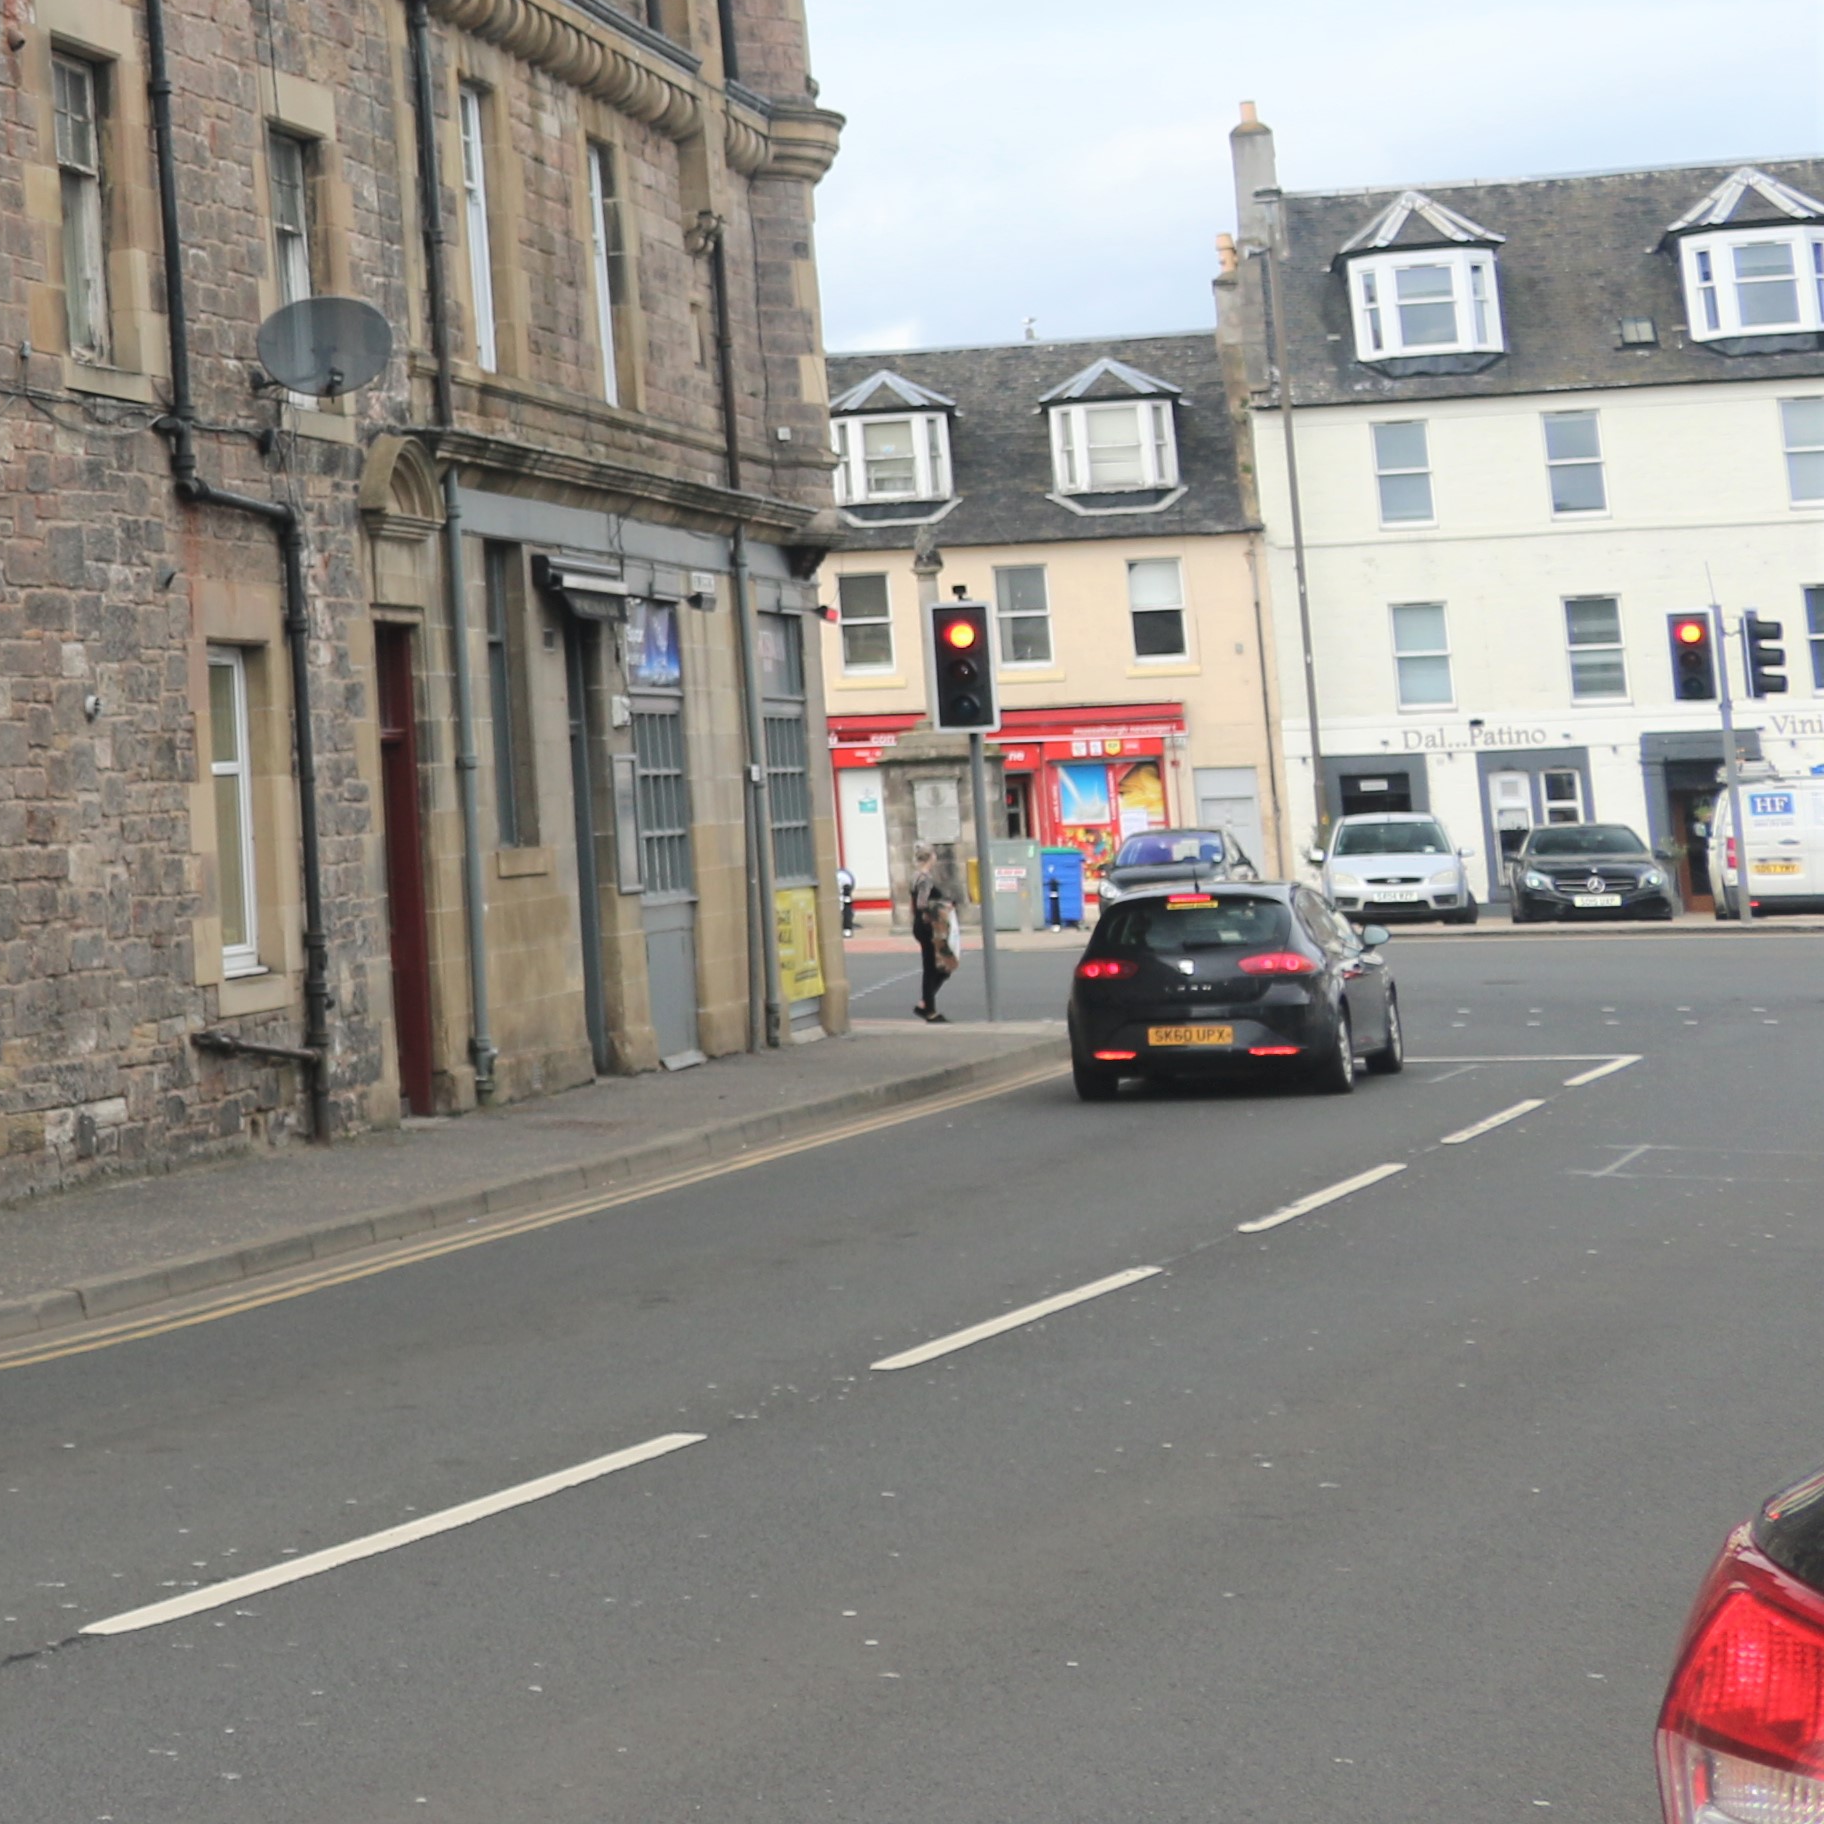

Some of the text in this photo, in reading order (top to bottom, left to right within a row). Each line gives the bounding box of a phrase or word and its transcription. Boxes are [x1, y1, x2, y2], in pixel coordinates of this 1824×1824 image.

[1754, 796, 1789, 814] HF
[1154, 1028, 1225, 1043] SK60 UPX
